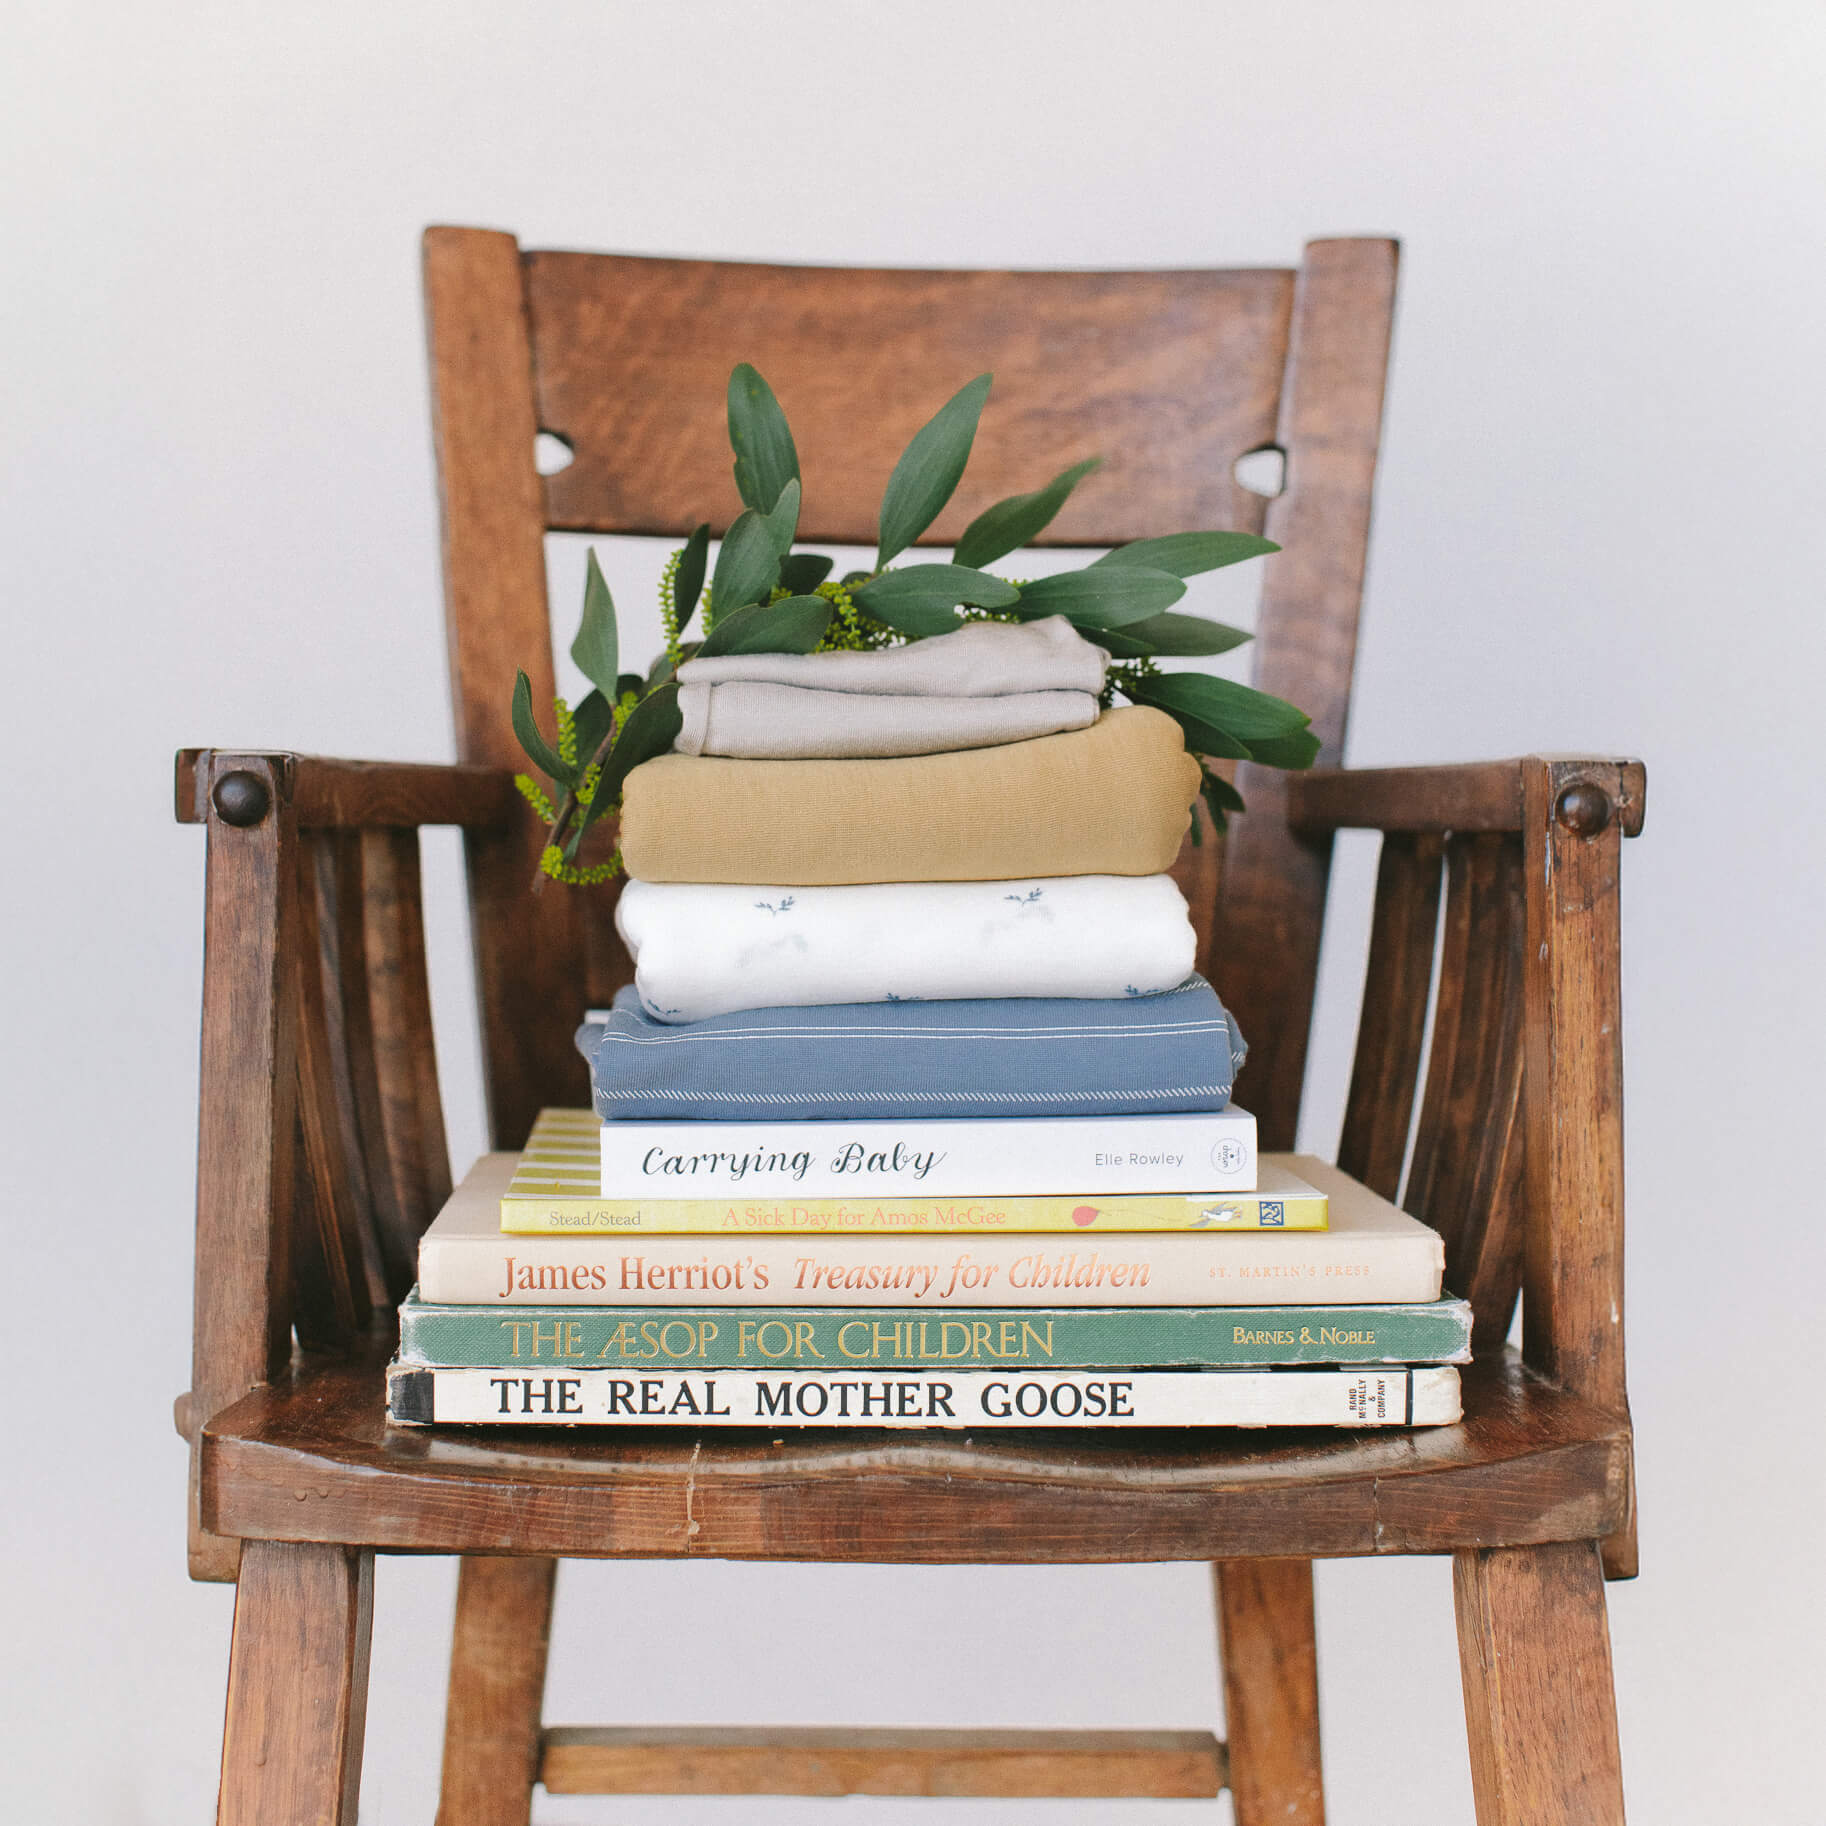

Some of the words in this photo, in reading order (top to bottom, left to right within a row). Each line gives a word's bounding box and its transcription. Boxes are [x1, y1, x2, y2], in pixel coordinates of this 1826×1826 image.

[641, 1147, 816, 1180] Carrying
[831, 1141, 949, 1180] Baby
[1094, 1153, 1123, 1166] Elle
[1129, 1152, 1185, 1168] Rowley
[549, 1210, 642, 1227] Stead/Stead
[721, 1207, 739, 1226] A
[744, 1207, 785, 1226] Sick
[792, 1207, 832, 1230] Day
[837, 1207, 865, 1226] for
[870, 1207, 929, 1225] Amos
[935, 1206, 1007, 1225] McGee
[499, 1257, 608, 1299] James
[618, 1256, 770, 1291] Herriot's
[793, 1257, 937, 1299] Treasury
[937, 1253, 998, 1300] for
[1009, 1253, 1152, 1289] Children
[1209, 1266, 1233, 1279] ST.
[1239, 1264, 1317, 1278] MARTIN'S
[1324, 1264, 1370, 1277] PRESS
[500, 1320, 586, 1359] THE
[598, 1320, 718, 1359] ÆSOP
[736, 1320, 826, 1359] FOR
[836, 1320, 1055, 1361] CHILDREN
[1299, 1326, 1319, 1345] &
[490, 1378, 584, 1415] THE
[606, 1379, 731, 1416] REAL
[754, 1380, 957, 1418] MOTHER
[980, 1381, 1135, 1418] GOOSE
[1349, 1388, 1357, 1410] RAND
[1377, 1379, 1386, 1418] COMPANY
